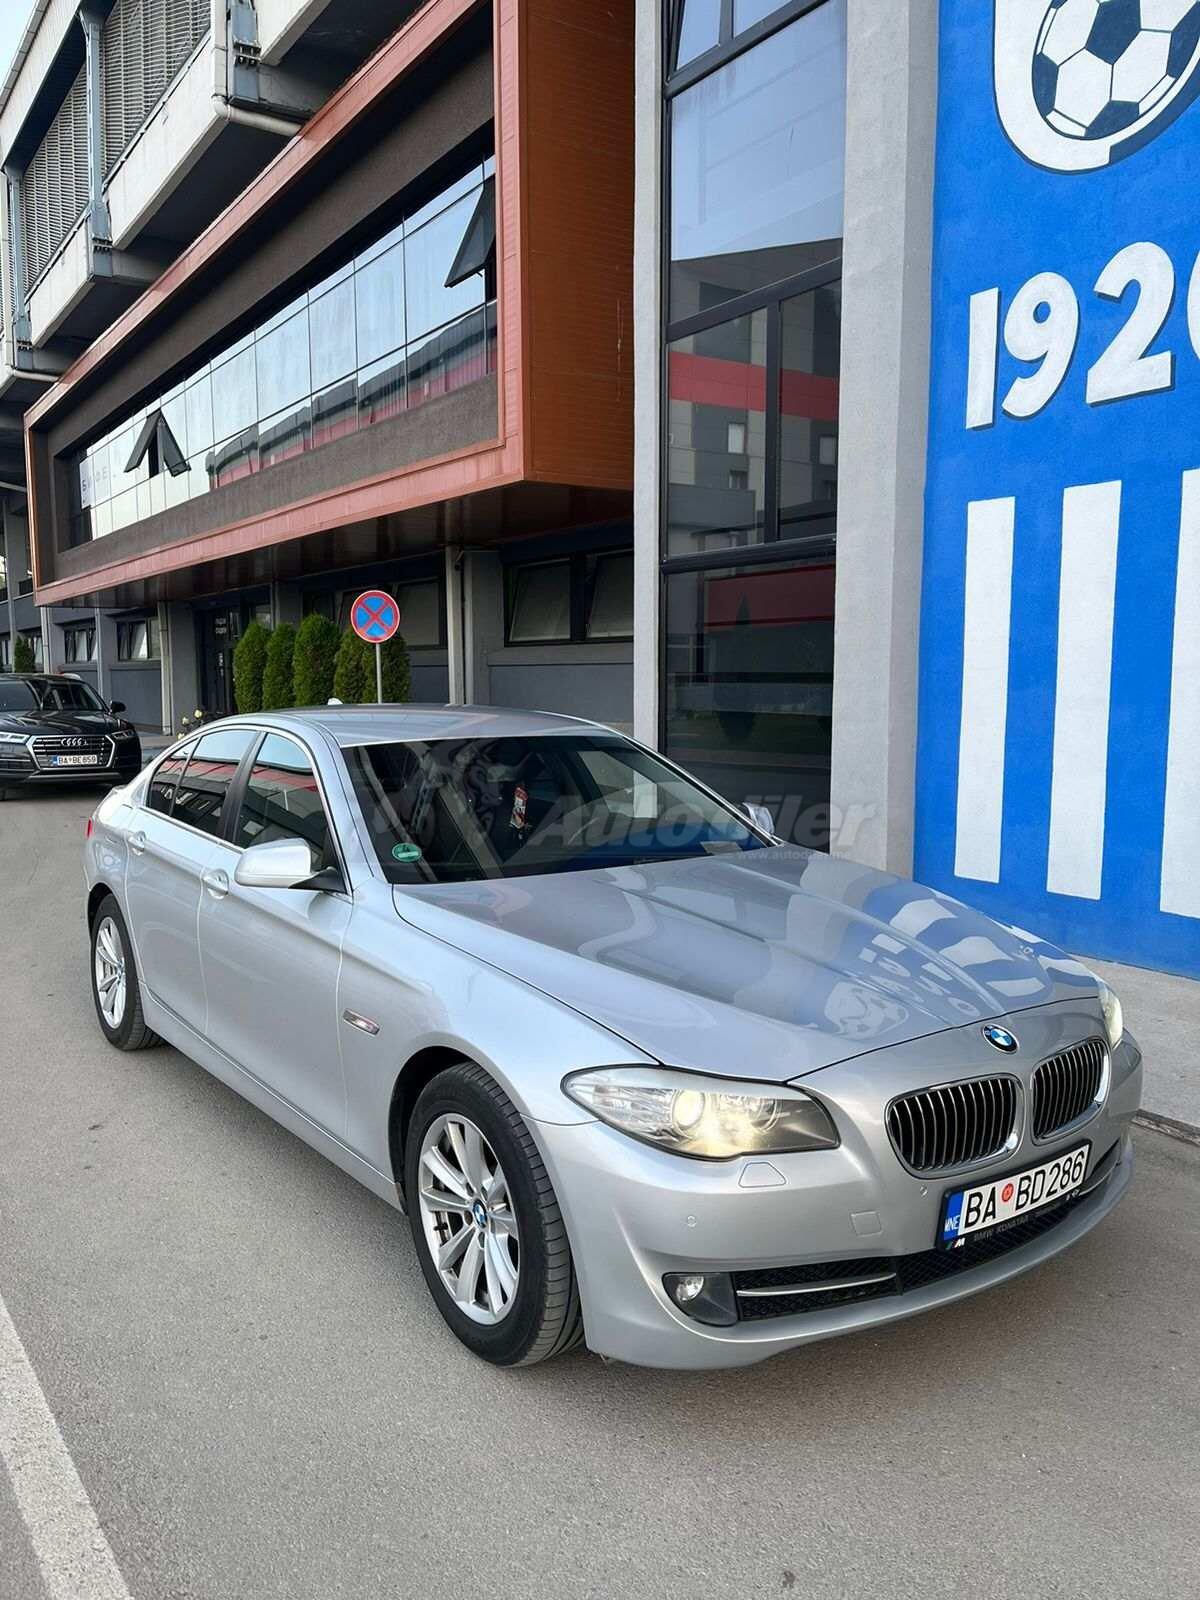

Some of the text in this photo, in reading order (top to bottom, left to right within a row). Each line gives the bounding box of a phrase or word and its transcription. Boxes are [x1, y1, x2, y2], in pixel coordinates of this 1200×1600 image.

[966, 241, 1200, 429] 192
[964, 1150, 1085, 1229] BA BD286
